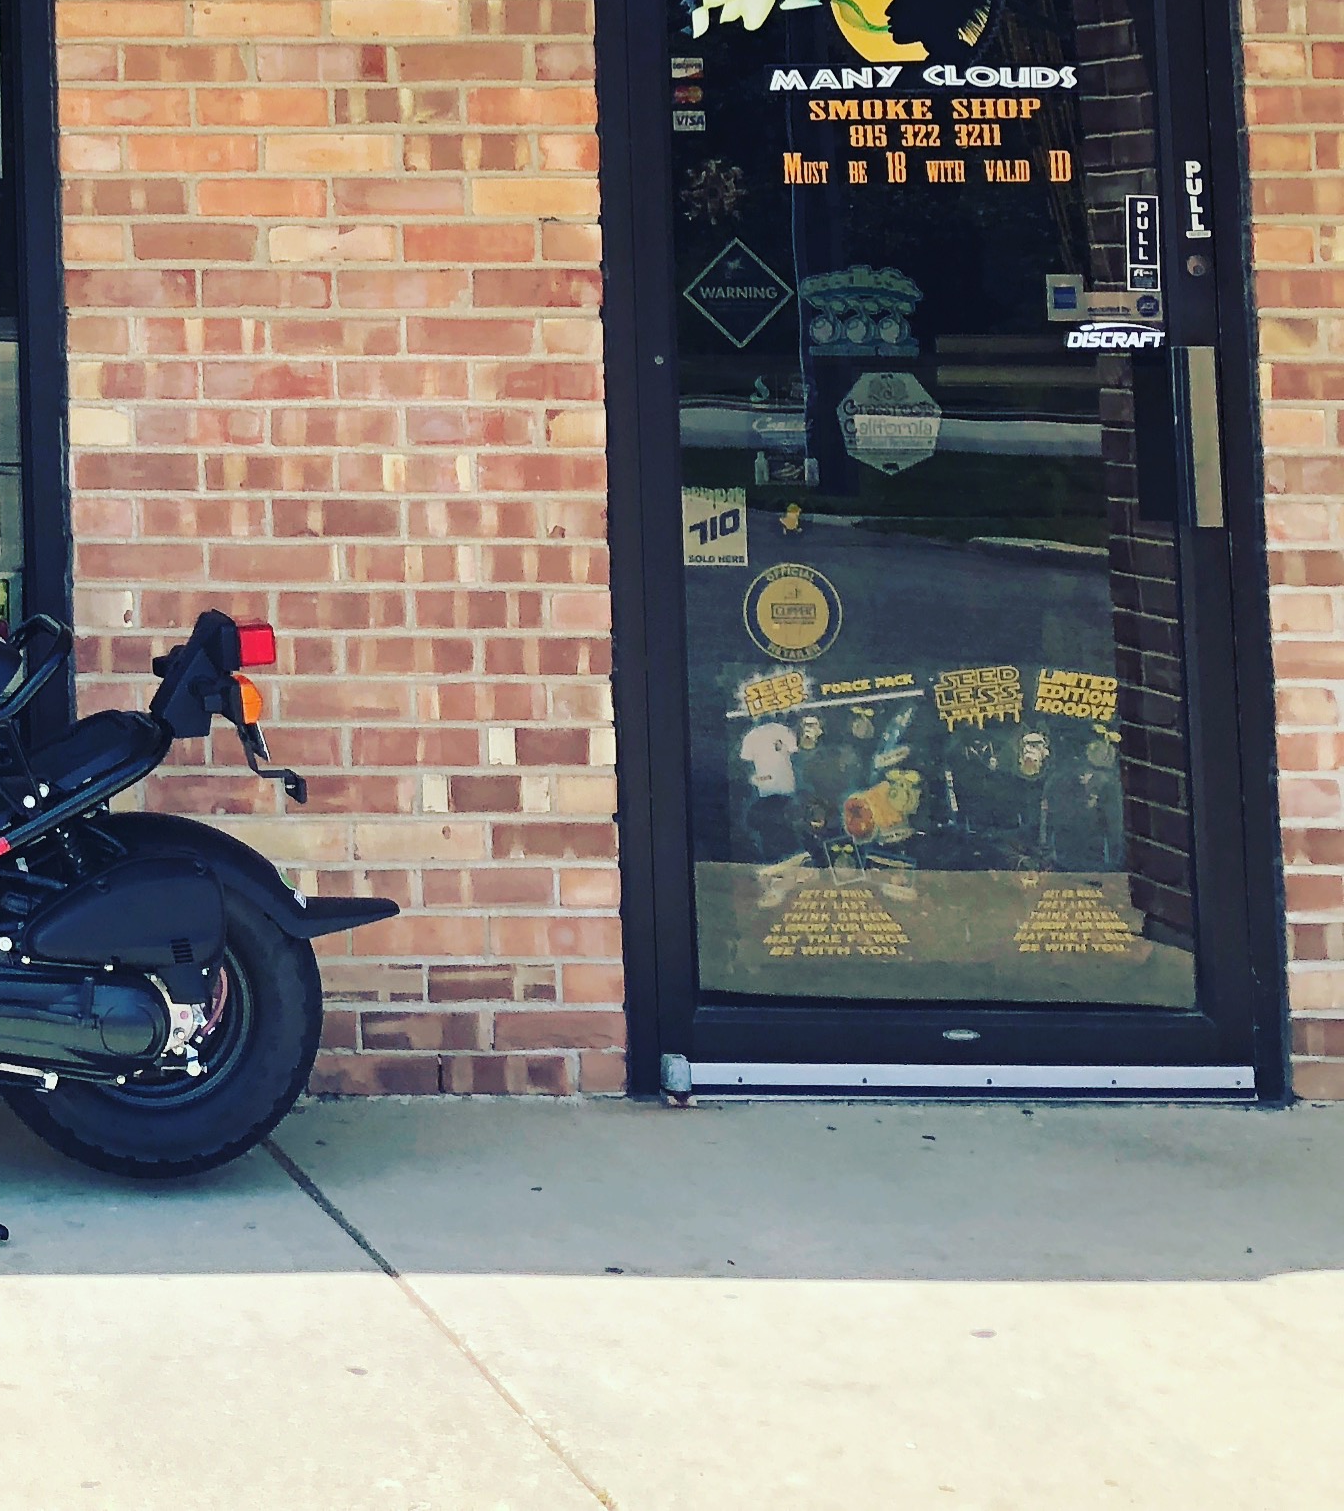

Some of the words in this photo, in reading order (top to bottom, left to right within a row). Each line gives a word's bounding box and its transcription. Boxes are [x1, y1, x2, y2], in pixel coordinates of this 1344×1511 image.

[769, 66, 903, 90] MANY
[923, 64, 1078, 88] CLOUDS
[809, 99, 933, 121] SMOKE
[951, 98, 1041, 119] SHOP
[849, 124, 888, 147] 815
[901, 124, 941, 147] 322
[954, 124, 1002, 147] 3211
[885, 151, 907, 183] 18
[1048, 150, 1072, 182] ID
[1184, 160, 1205, 231] PULL
[1136, 201, 1149, 261] PULL
[699, 286, 778, 299] WARNING
[1067, 331, 1165, 348] DISCRAFT
[842, 398, 938, 417] Grassroots
[843, 418, 933, 436] California
[688, 554, 716, 564] SOLD
[718, 554, 745, 564] HERE
[765, 566, 815, 583] OFFICIAL
[766, 641, 821, 660] RETAILER
[744, 671, 804, 698] SEED
[820, 678, 872, 695] FORCE
[875, 673, 915, 689] PACK
[934, 665, 1020, 690] SEED
[1038, 668, 1118, 692] LIMITED
[744, 689, 807, 718] LESS
[935, 683, 1022, 710] LESS
[1037, 683, 1118, 708] EDITION
[1034, 698, 1116, 721] HOODYS
[782, 912, 830, 922] THINK
[837, 912, 893, 922] GREEN
[762, 934, 801, 944] MAY
[807, 934, 842, 944] THE
[1013, 932, 1044, 941] MAY
[1049, 932, 1079, 941] THE
[1045, 943, 1088, 952] WITH
[768, 946, 796, 956] BE
[800, 946, 852, 956] WITH
